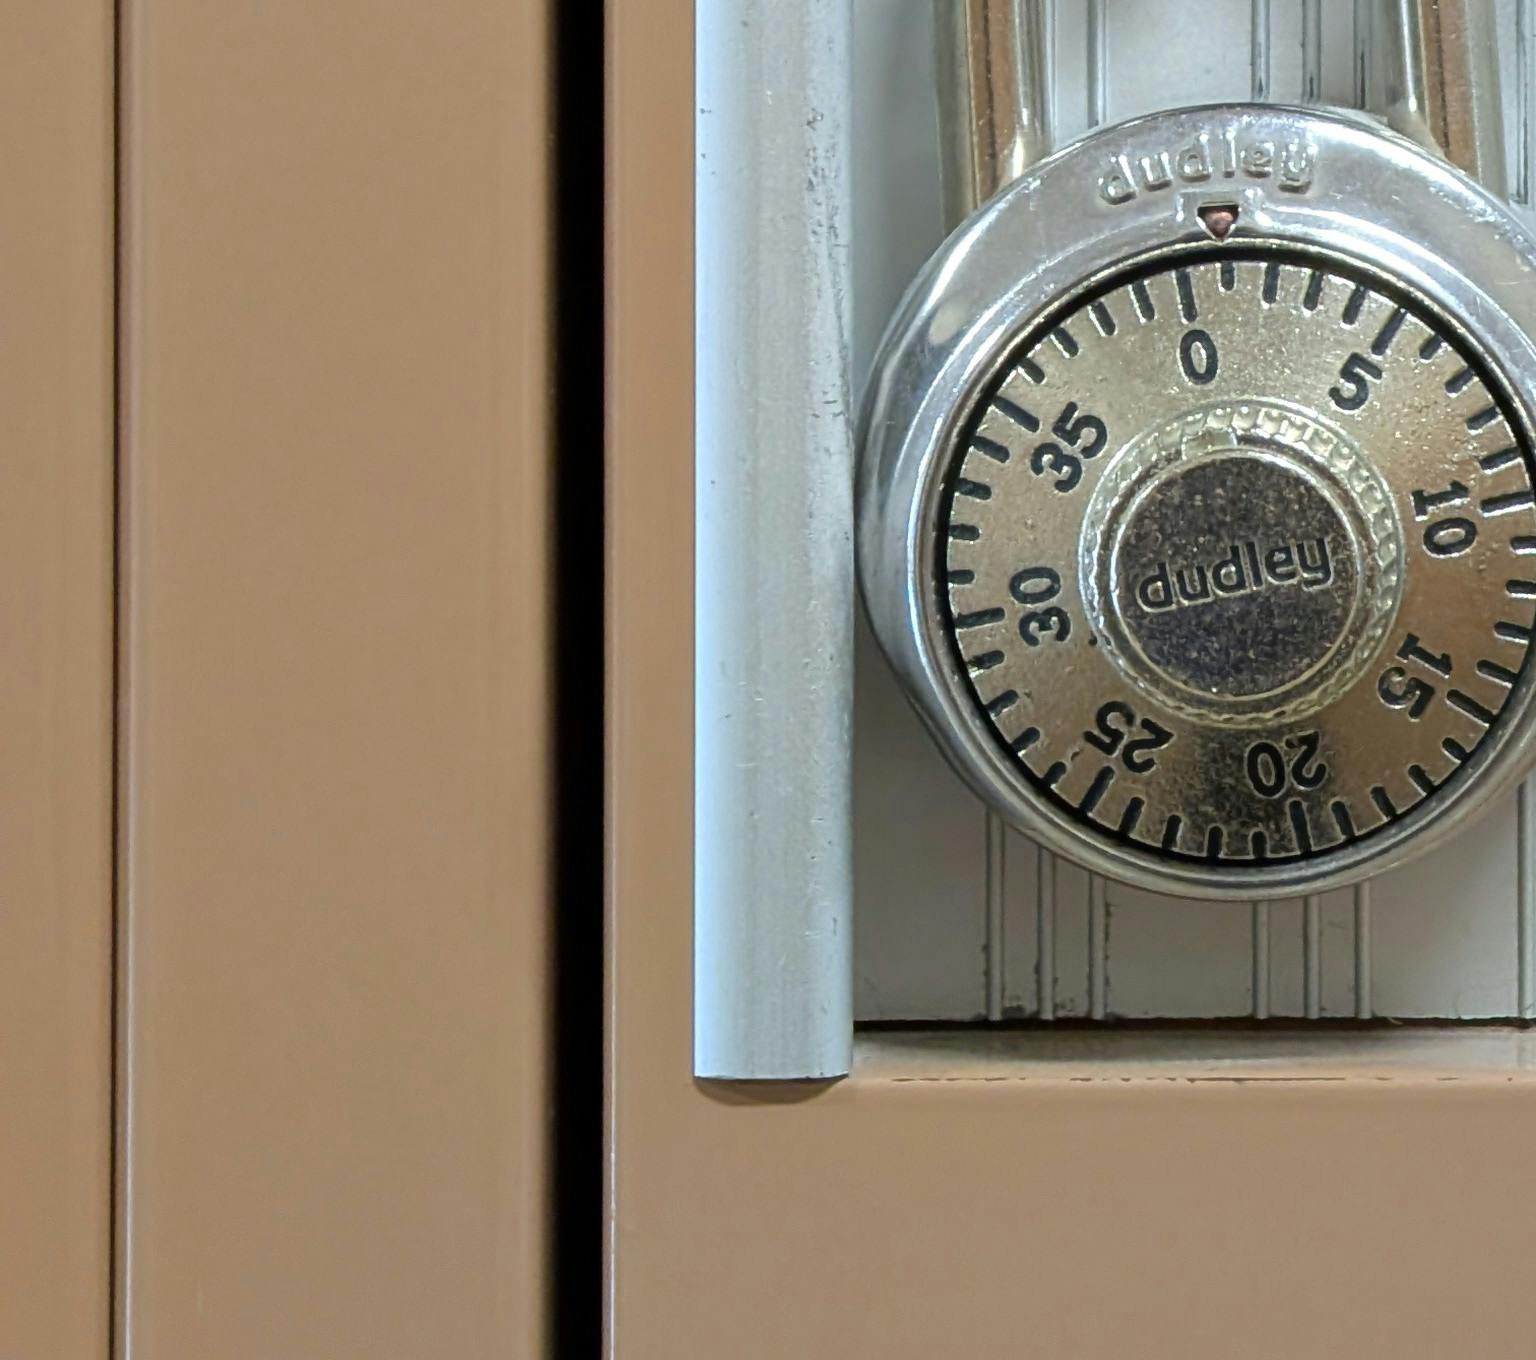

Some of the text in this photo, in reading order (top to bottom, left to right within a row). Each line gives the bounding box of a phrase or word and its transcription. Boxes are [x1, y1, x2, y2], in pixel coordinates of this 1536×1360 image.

[1098, 129, 1319, 206] dudley
[1178, 328, 1220, 386] 0
[1328, 351, 1384, 411] 5
[1029, 400, 1109, 493] 35
[1410, 480, 1478, 559] 10
[1009, 565, 1072, 648] 30
[1136, 537, 1335, 614] dudley
[1375, 632, 1454, 722] 15
[1082, 700, 1176, 774] 25
[1246, 730, 1328, 799] 20
